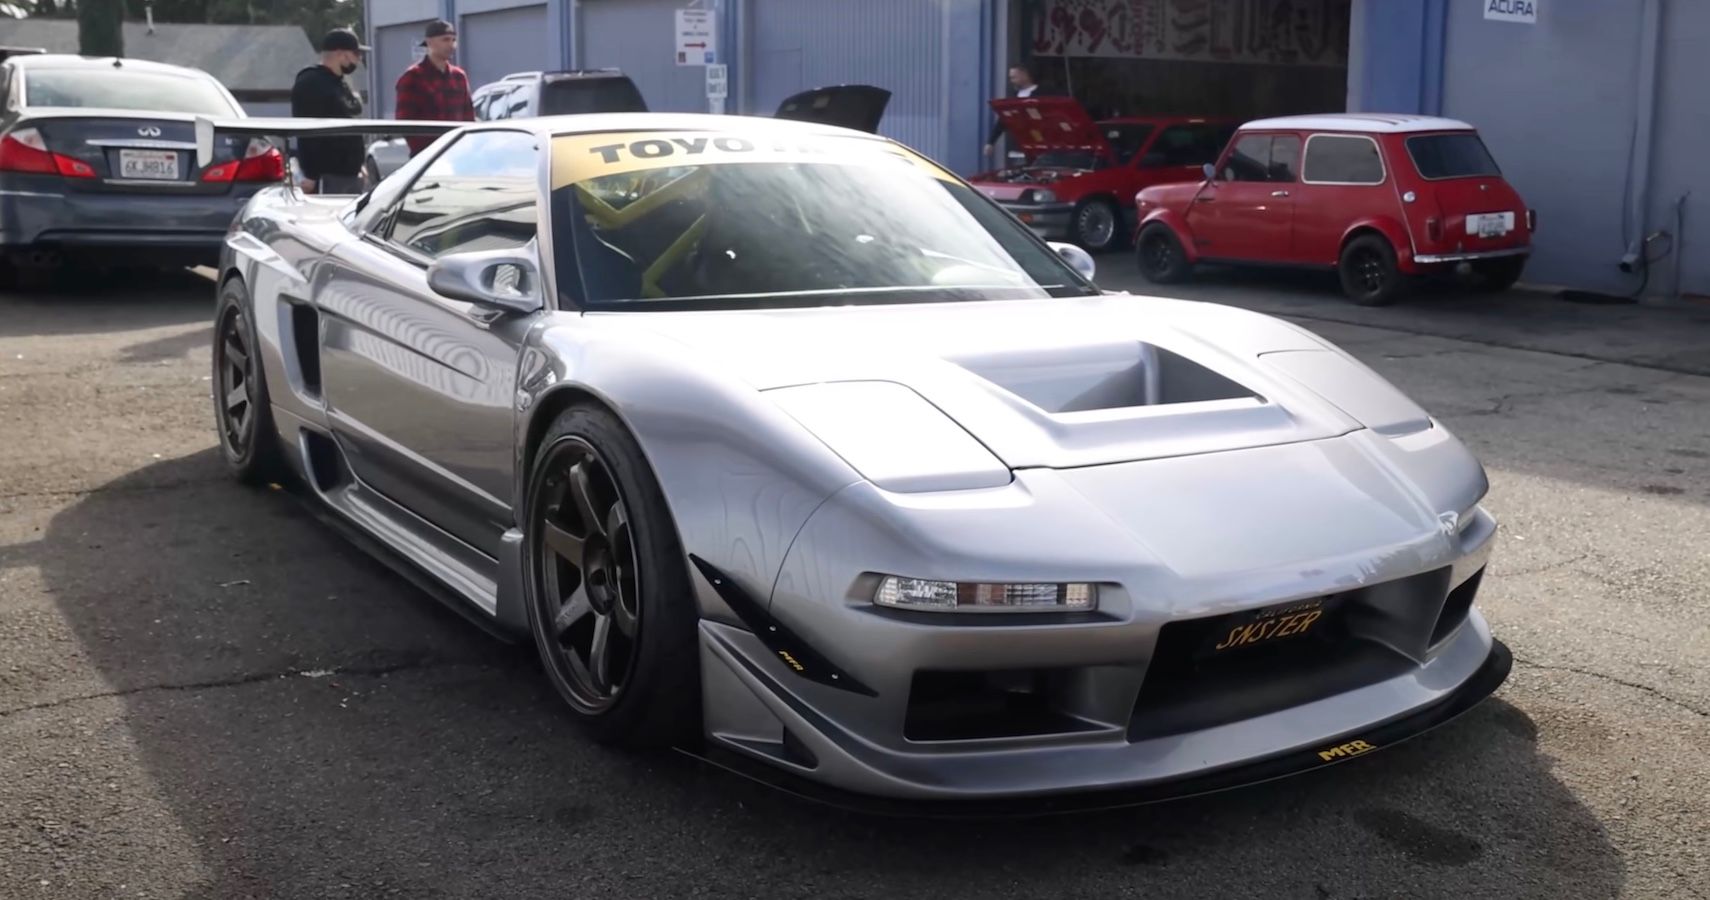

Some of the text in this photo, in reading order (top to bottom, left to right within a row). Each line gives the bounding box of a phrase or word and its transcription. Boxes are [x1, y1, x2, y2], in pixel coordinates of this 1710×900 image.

[1487, 0, 1534, 16] ACURA
[589, 136, 754, 164] TOYO
[1215, 610, 1322, 650] SNSTER
